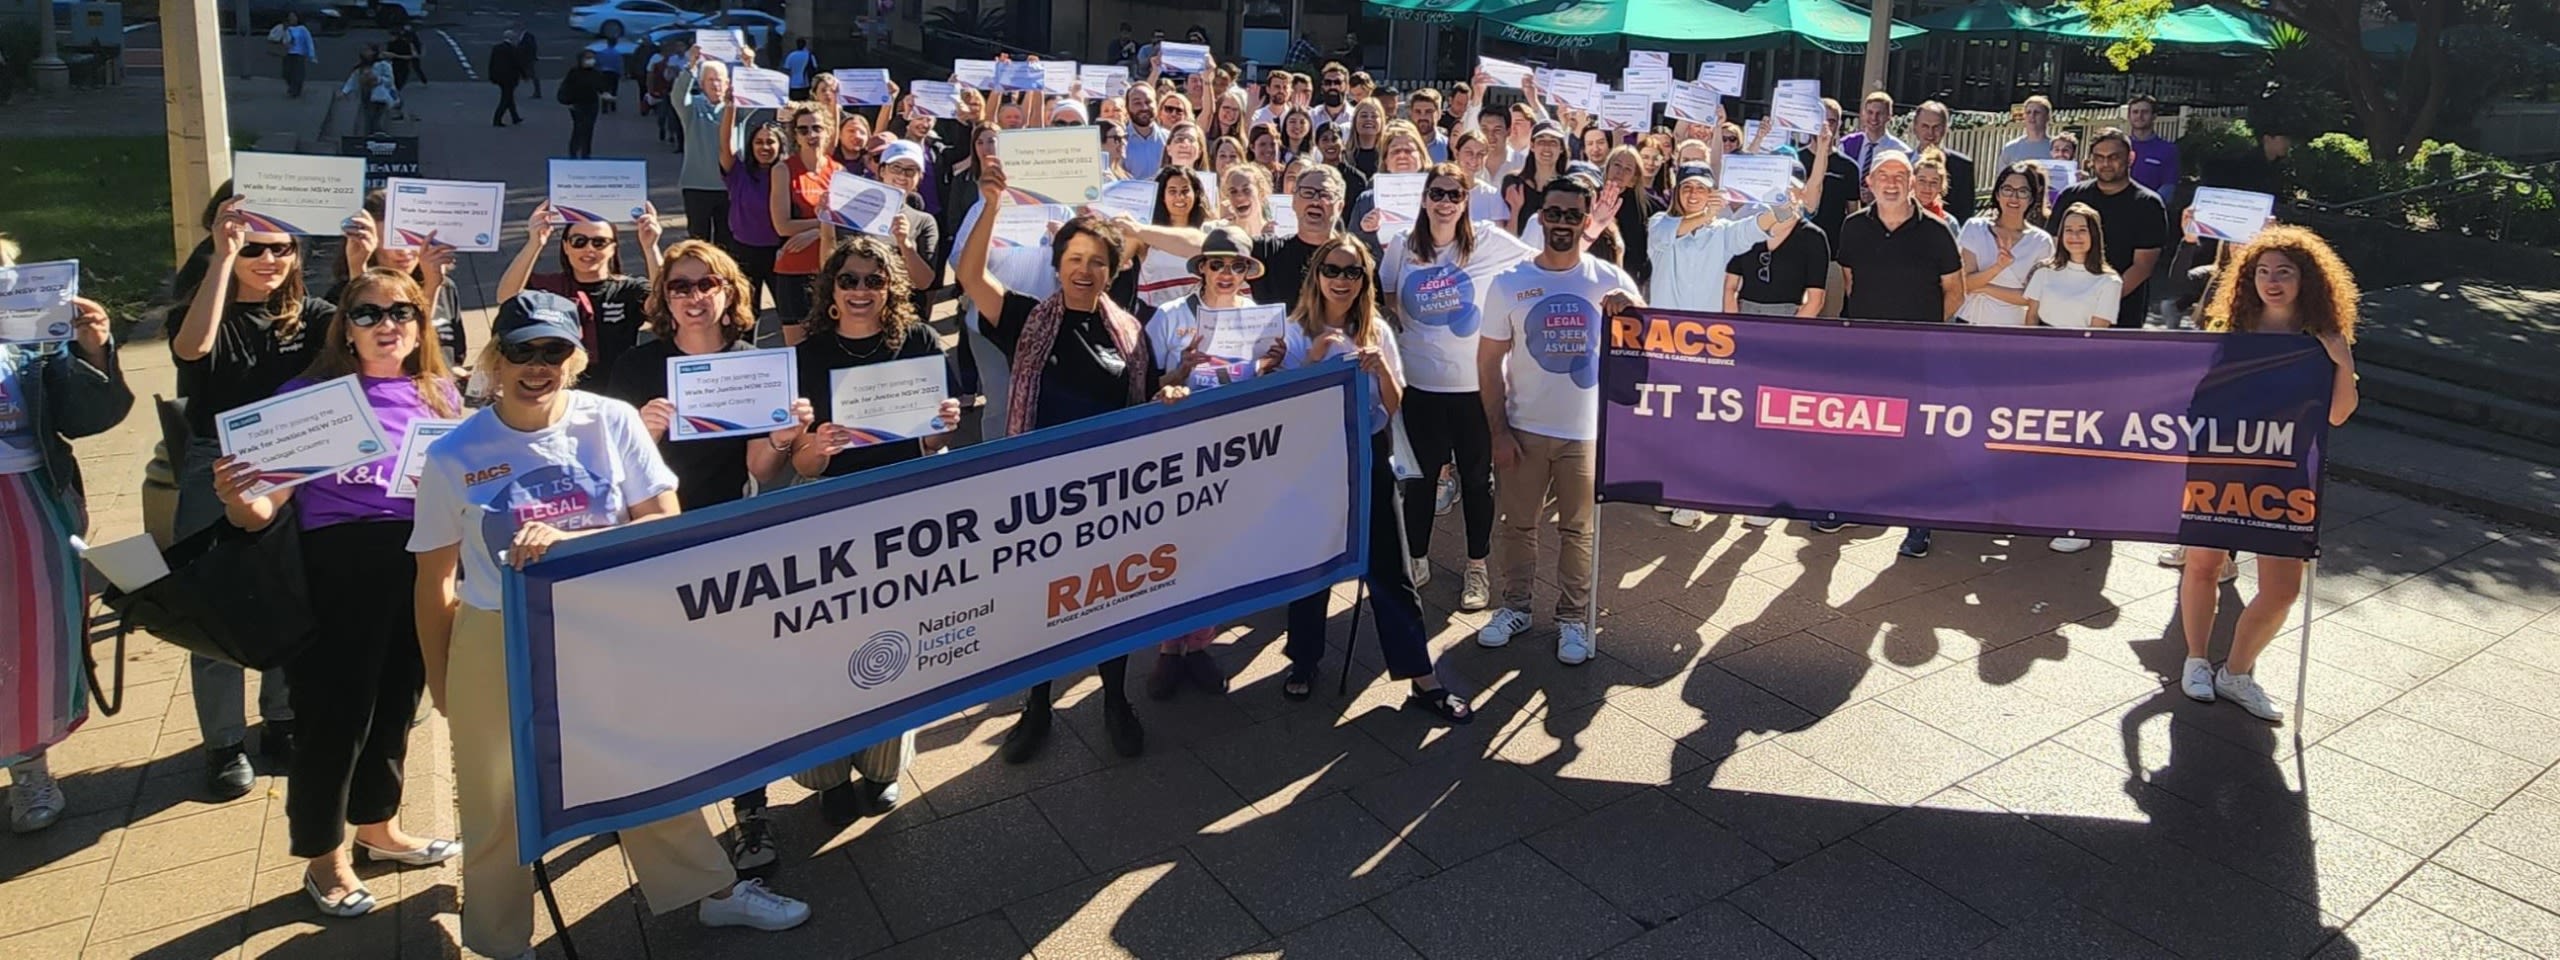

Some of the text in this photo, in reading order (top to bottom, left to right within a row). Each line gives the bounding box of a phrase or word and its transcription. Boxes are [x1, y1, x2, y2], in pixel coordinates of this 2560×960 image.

[1500, 25, 1544, 42] METRO
[1557, 34, 1594, 48] JAMES
[258, 172, 282, 181] Today
[366, 163, 418, 173] E-AWAY
[1415, 286, 1461, 302] TO SEEK
[1420, 279, 1452, 291] LEGAL
[1517, 288, 1544, 301] RACS
[1420, 298, 1460, 313] ASYLUM
[1549, 303, 1579, 313] IT IS
[1546, 317, 1584, 327] LEGAL
[1542, 330, 1588, 339] TO SEEK
[1610, 316, 1736, 358] RACS
[1545, 343, 1586, 353] ASYLUM
[1610, 349, 1639, 357] REFUGEE
[717, 385, 743, 394] Justice
[763, 381, 782, 389] 2022
[841, 398, 859, 406] Walk
[873, 392, 900, 401] Justice
[901, 389, 920, 397] NSW
[921, 386, 940, 394] 2022
[248, 426, 274, 440] Today
[290, 414, 319, 428] joining
[320, 408, 334, 417] the
[1634, 383, 2296, 456] IT IS LEGAL TO SEEK ASYLUM
[238, 414, 353, 456] Walk for Justice NSW 2022
[296, 438, 330, 453] Country
[336, 465, 390, 487] K&L
[464, 463, 512, 485] RACS
[552, 477, 574, 494] IS
[519, 497, 586, 522] LEGAL
[2182, 481, 2316, 524] RACS
[549, 513, 594, 530] EEK
[676, 424, 1283, 621] WALK FOR JUSTICE NSW
[2181, 513, 2211, 522] REFUGEE
[2213, 515, 2239, 524] ADVICE
[2247, 520, 2286, 530] CASEWORK
[774, 479, 1229, 638] NATIONAL PRO BONO DAY
[1047, 543, 1177, 619] RACS
[1047, 613, 1079, 628] REFUGEE
[1080, 603, 1105, 617] ADVICE
[1111, 589, 1148, 606] CASEWORK
[1150, 579, 1177, 593] SERVICE
[919, 598, 994, 636] National
[916, 624, 976, 657] Justice
[918, 640, 981, 671] Project
